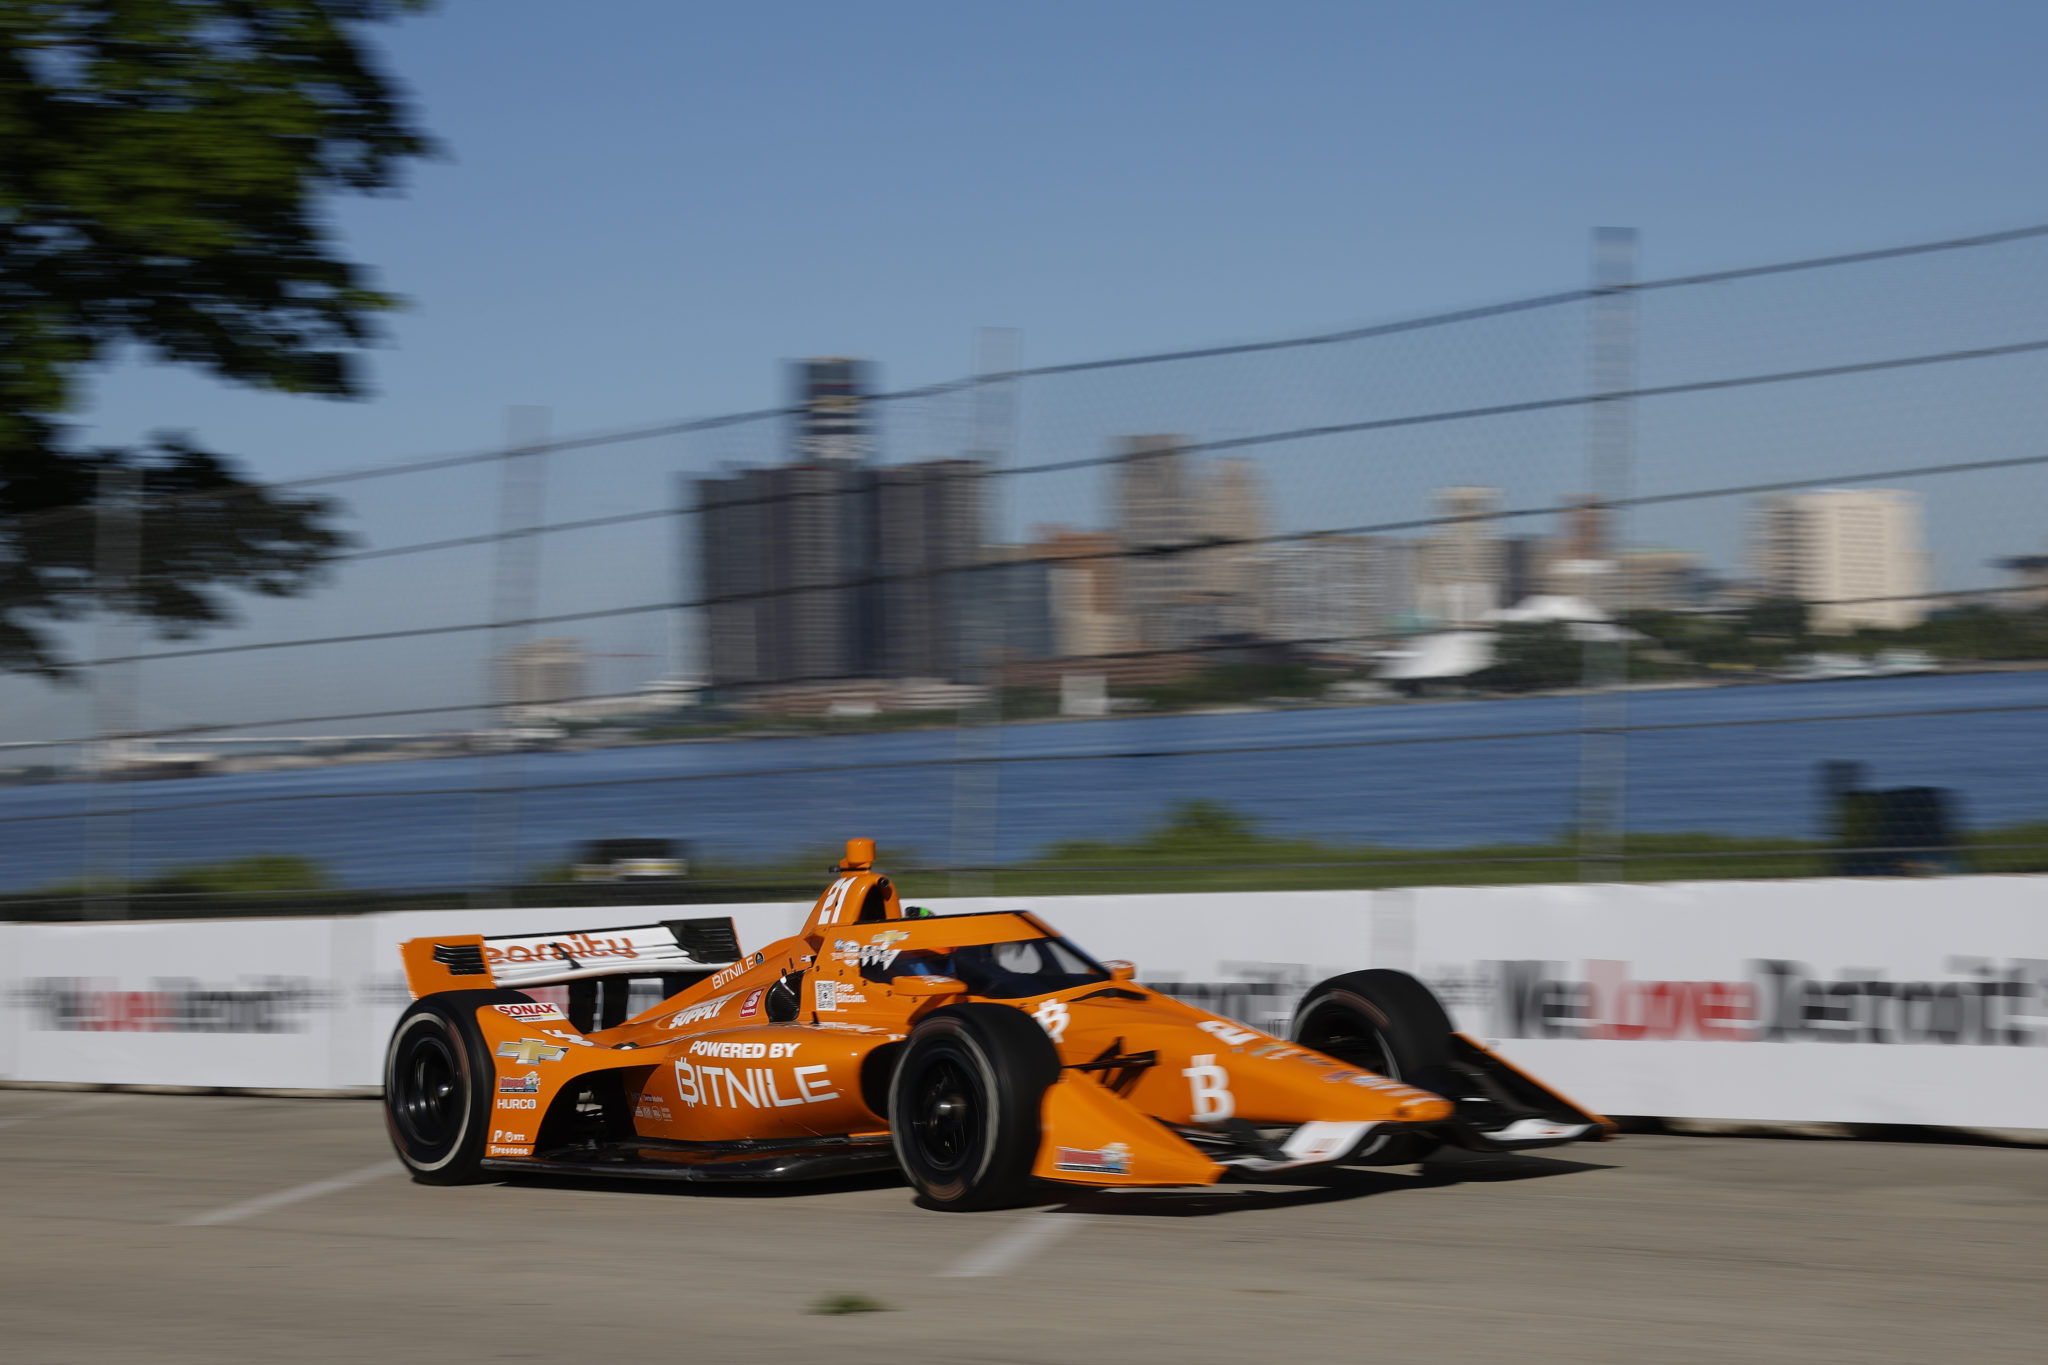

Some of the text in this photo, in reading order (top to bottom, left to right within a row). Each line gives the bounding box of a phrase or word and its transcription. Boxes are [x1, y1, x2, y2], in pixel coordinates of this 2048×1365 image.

[818, 876, 858, 925] 21
[711, 957, 756, 989] BITNILE
[498, 1003, 557, 1016] SONAX
[668, 1000, 727, 1030] SUPPLY
[689, 1041, 802, 1059] POWERED BY
[674, 1056, 841, 1109] BITNILE
[497, 1099, 537, 1109] HURCO
[491, 1145, 529, 1155] Firestone
